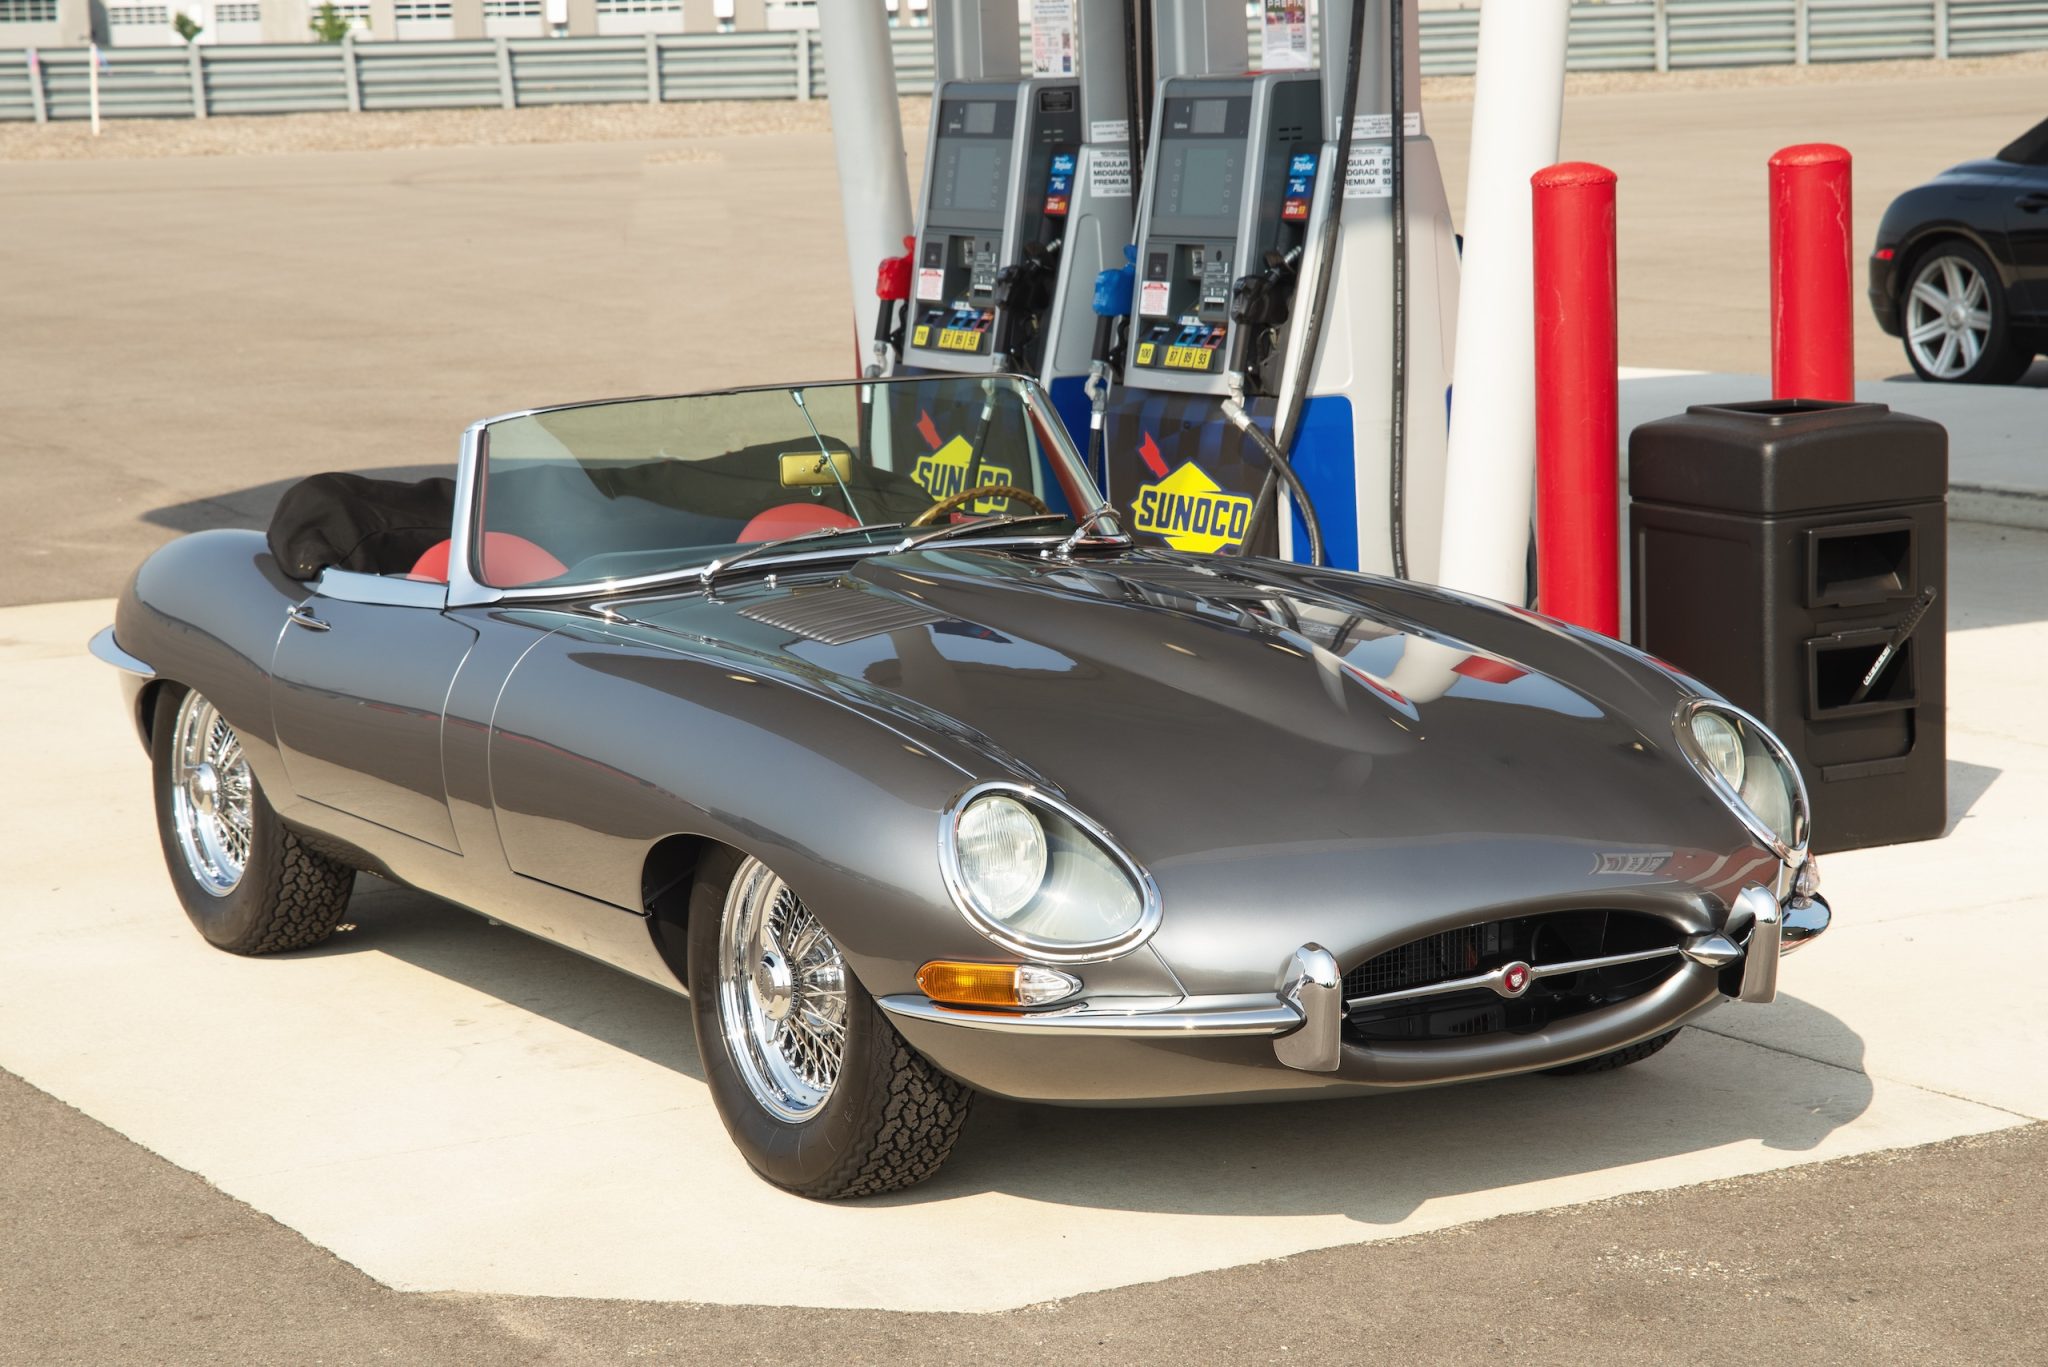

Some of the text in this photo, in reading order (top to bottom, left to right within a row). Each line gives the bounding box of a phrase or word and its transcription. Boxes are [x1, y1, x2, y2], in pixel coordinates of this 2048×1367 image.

[1093, 160, 1128, 168] REGULAR
[1347, 159, 1375, 167] GULAR
[1346, 168, 1380, 176] DGRADE
[1093, 178, 1129, 186] PREMIUM
[1344, 178, 1376, 186] REMIUM
[942, 334, 951, 344] 87
[956, 335, 964, 345] 89
[968, 336, 976, 346] 93
[1141, 348, 1151, 358] 100
[1169, 351, 1178, 361] 87
[1184, 352, 1192, 363] 89
[1198, 353, 1207, 364] 93
[918, 461, 1010, 507] SUNCO
[1138, 490, 1249, 540] SUNOCO
